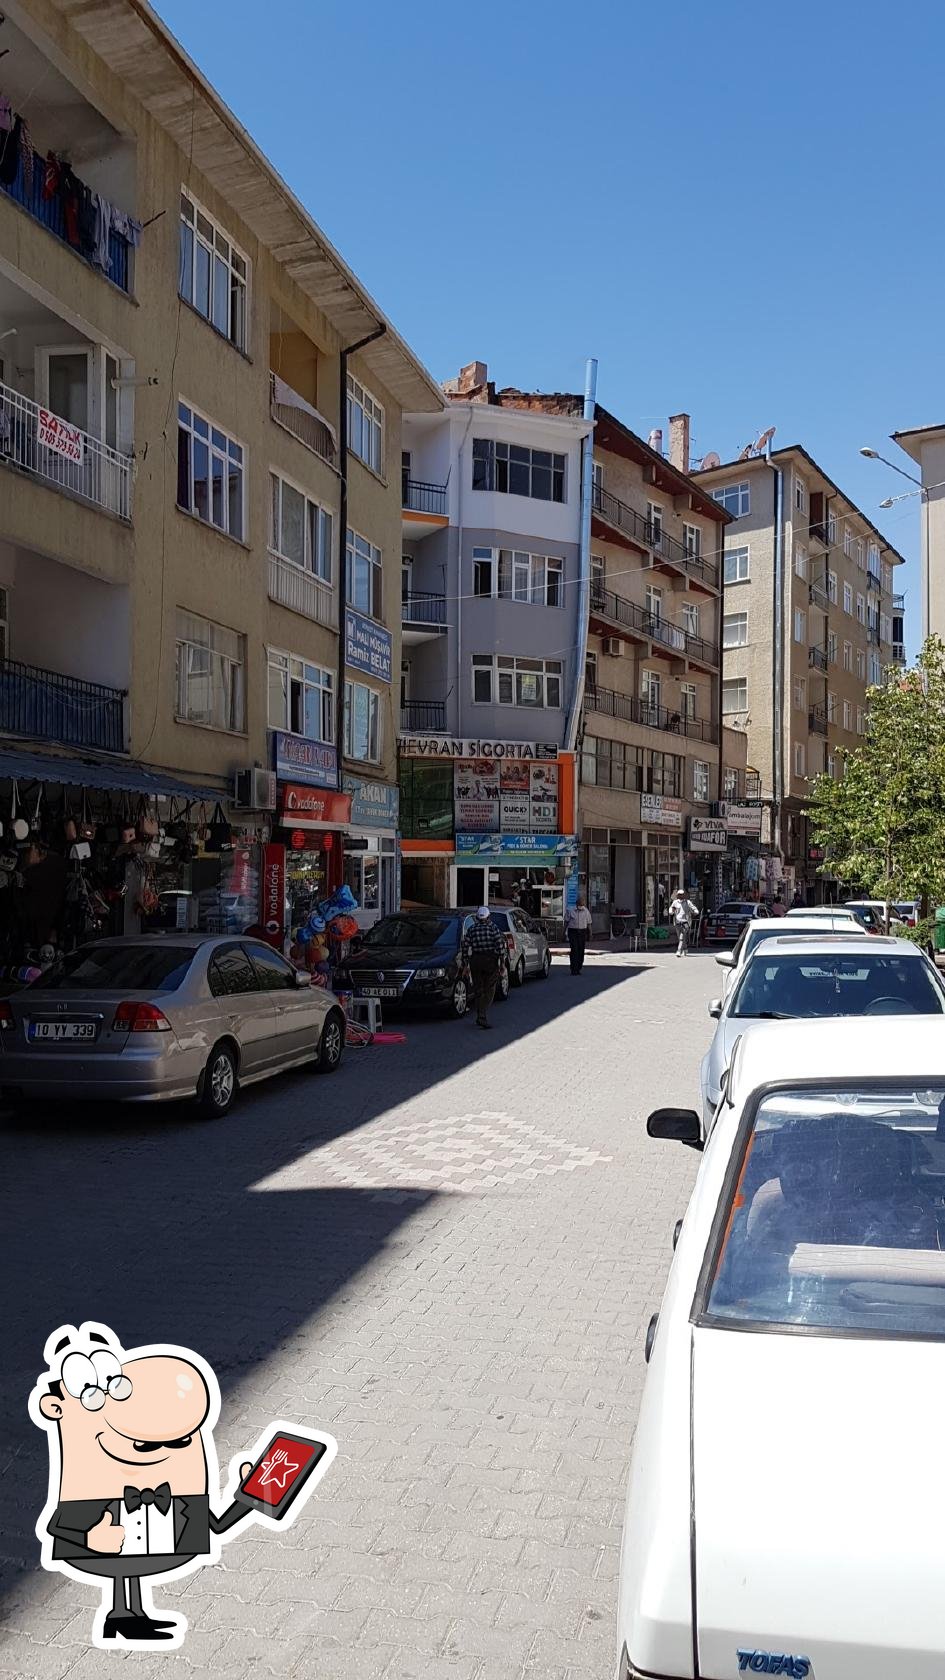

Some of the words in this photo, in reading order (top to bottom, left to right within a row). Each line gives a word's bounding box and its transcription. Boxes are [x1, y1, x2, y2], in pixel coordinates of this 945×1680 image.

[348, 641, 369, 663] Ramiz
[469, 740, 534, 758] SİGORTA
[269, 863, 280, 917] vodafone
[37, 1025, 49, 1036] 10
[55, 1025, 68, 1036] YY
[73, 1025, 94, 1036] 339
